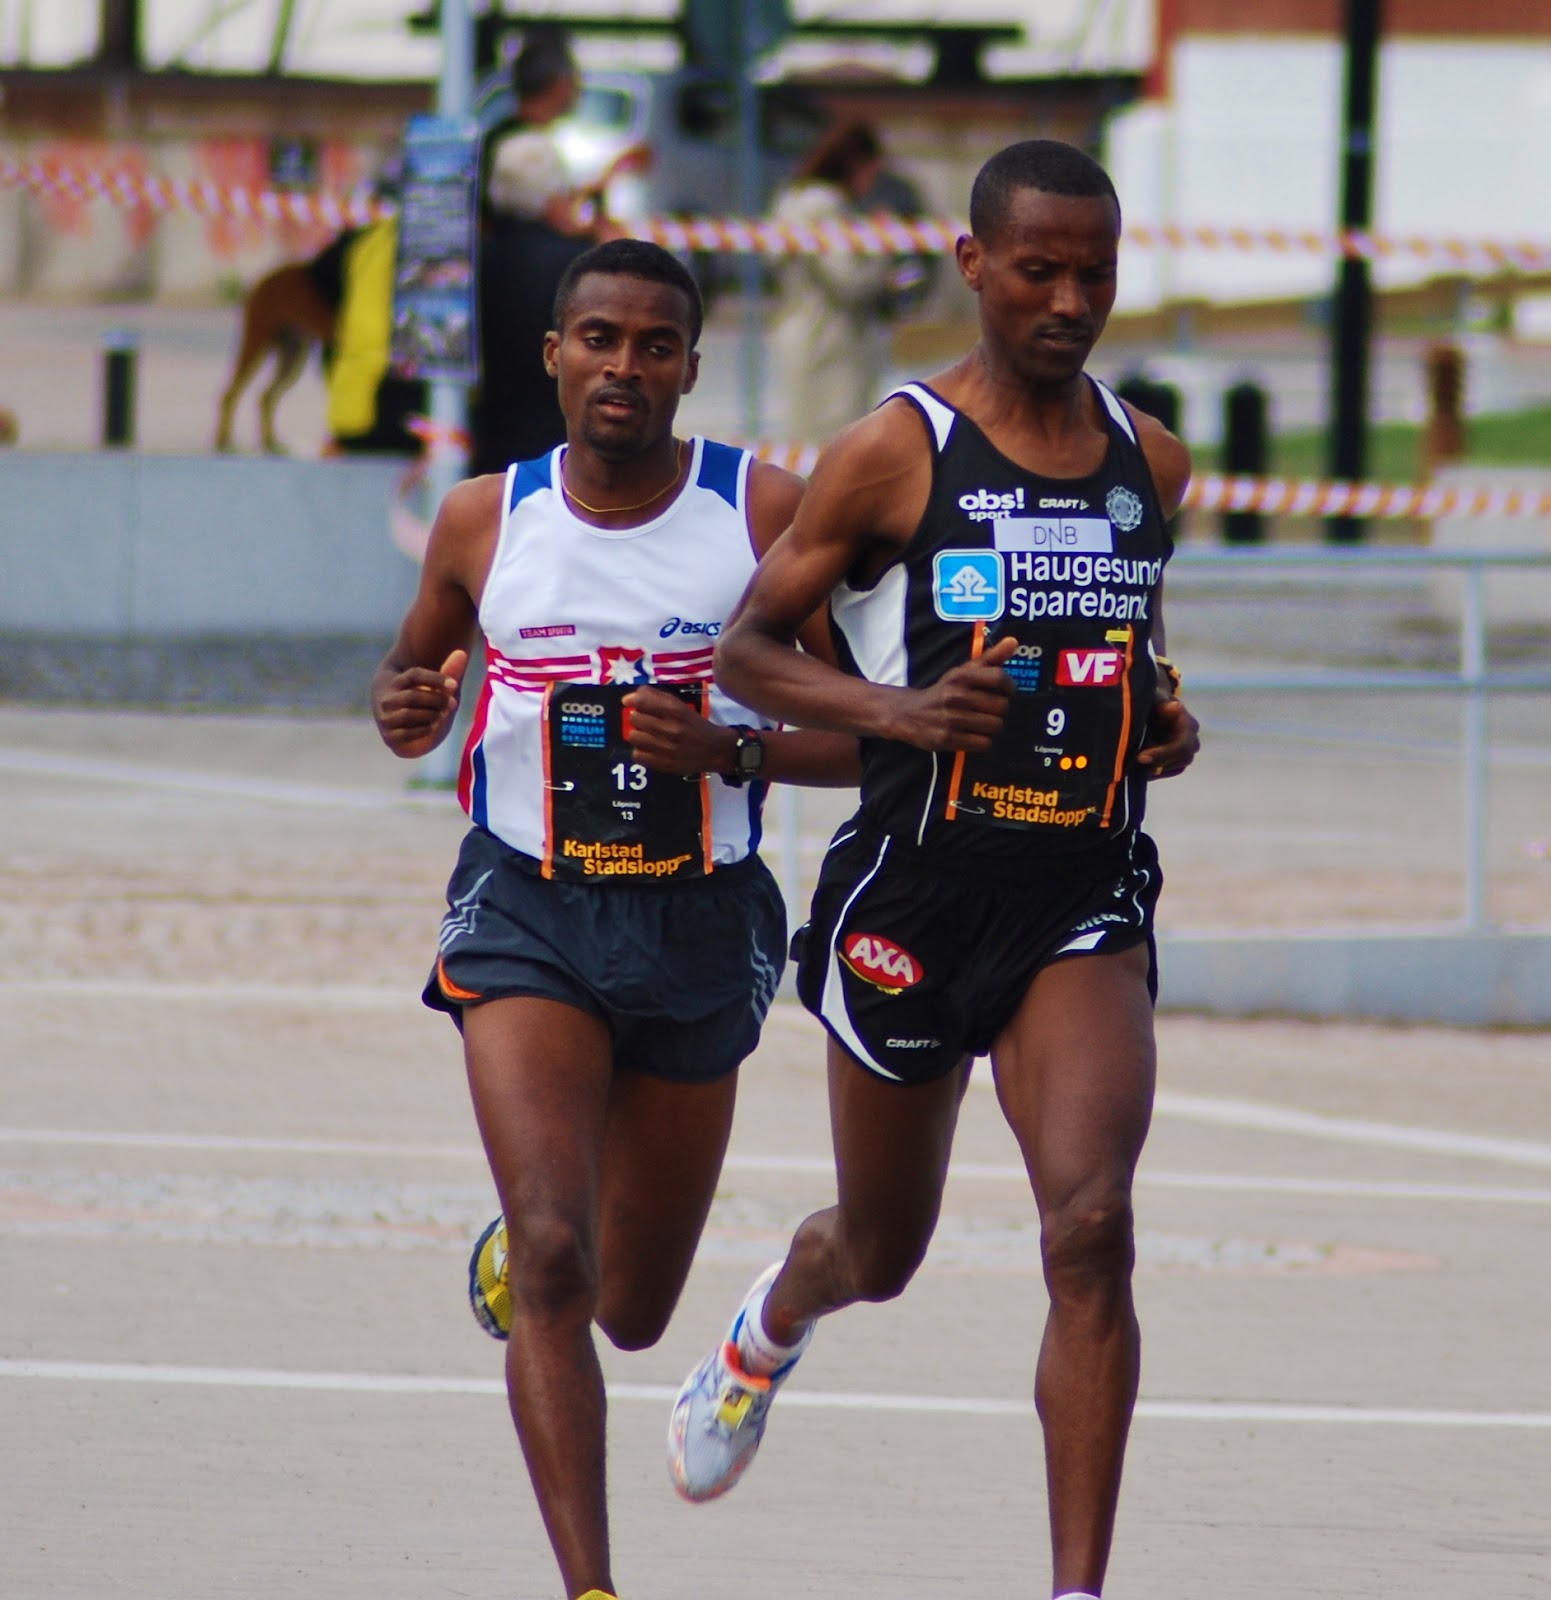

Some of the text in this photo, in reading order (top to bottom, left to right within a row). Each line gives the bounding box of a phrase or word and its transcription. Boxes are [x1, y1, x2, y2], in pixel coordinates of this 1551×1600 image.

[959, 487, 1025, 510] obs!
[1039, 498, 1079, 509] CRAFT
[969, 510, 1011, 522] sport
[1034, 520, 1078, 550] DNB
[1010, 552, 1162, 586] Haugesund
[1010, 587, 1148, 621] Sparebank
[1066, 652, 1117, 683] VF
[561, 702, 605, 717] coop
[561, 725, 605, 735] FORUM
[1046, 708, 1066, 736] 9
[1044, 757, 1052, 767] 9
[611, 762, 648, 791] 13
[972, 782, 1059, 807] Karlstad
[620, 810, 634, 821] 13
[993, 801, 1091, 827] Stadslopp
[563, 839, 643, 859] Karlstad
[583, 857, 684, 877] Stadslopp
[849, 936, 914, 983] AXA
[885, 1038, 931, 1049] CRAFT
